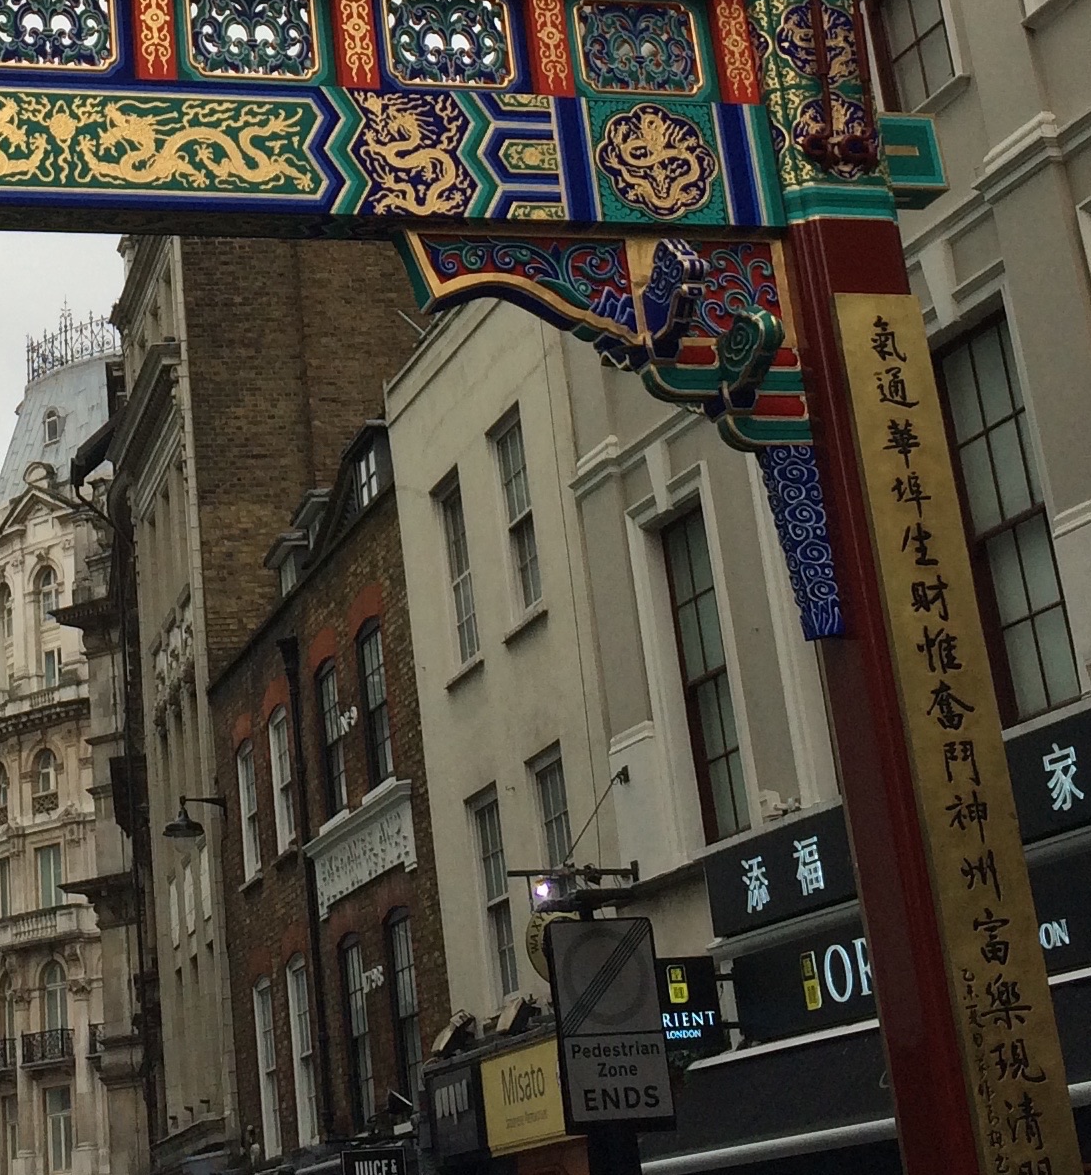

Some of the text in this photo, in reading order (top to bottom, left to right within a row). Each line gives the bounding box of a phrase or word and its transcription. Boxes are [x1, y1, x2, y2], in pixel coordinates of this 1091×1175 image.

[1042, 743, 1084, 810] 家
[662, 1011, 715, 1027] RIENT
[666, 1029, 701, 1039] LONDON
[571, 1041, 660, 1059] Pedestrian
[597, 1063, 638, 1077] Zone
[501, 1064, 545, 1106] Misato
[583, 1085, 660, 1111] ENDS
